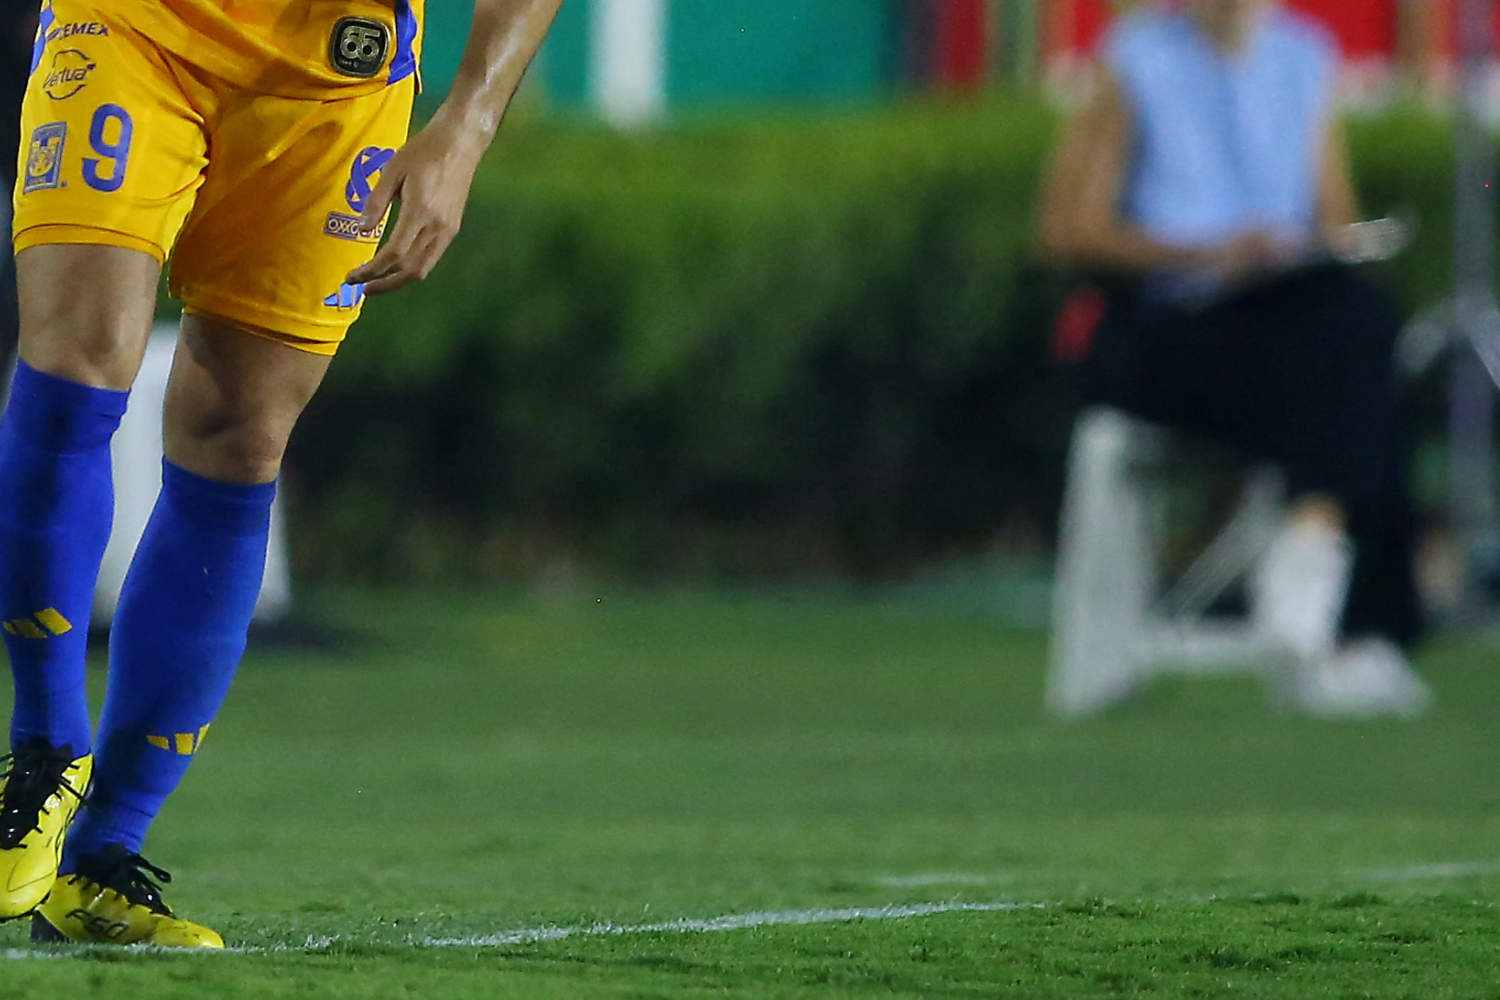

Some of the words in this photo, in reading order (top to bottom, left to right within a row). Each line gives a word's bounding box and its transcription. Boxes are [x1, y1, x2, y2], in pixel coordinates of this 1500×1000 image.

[58, 22, 109, 40] EMEX
[341, 25, 381, 62] 65
[82, 103, 134, 192] 9
